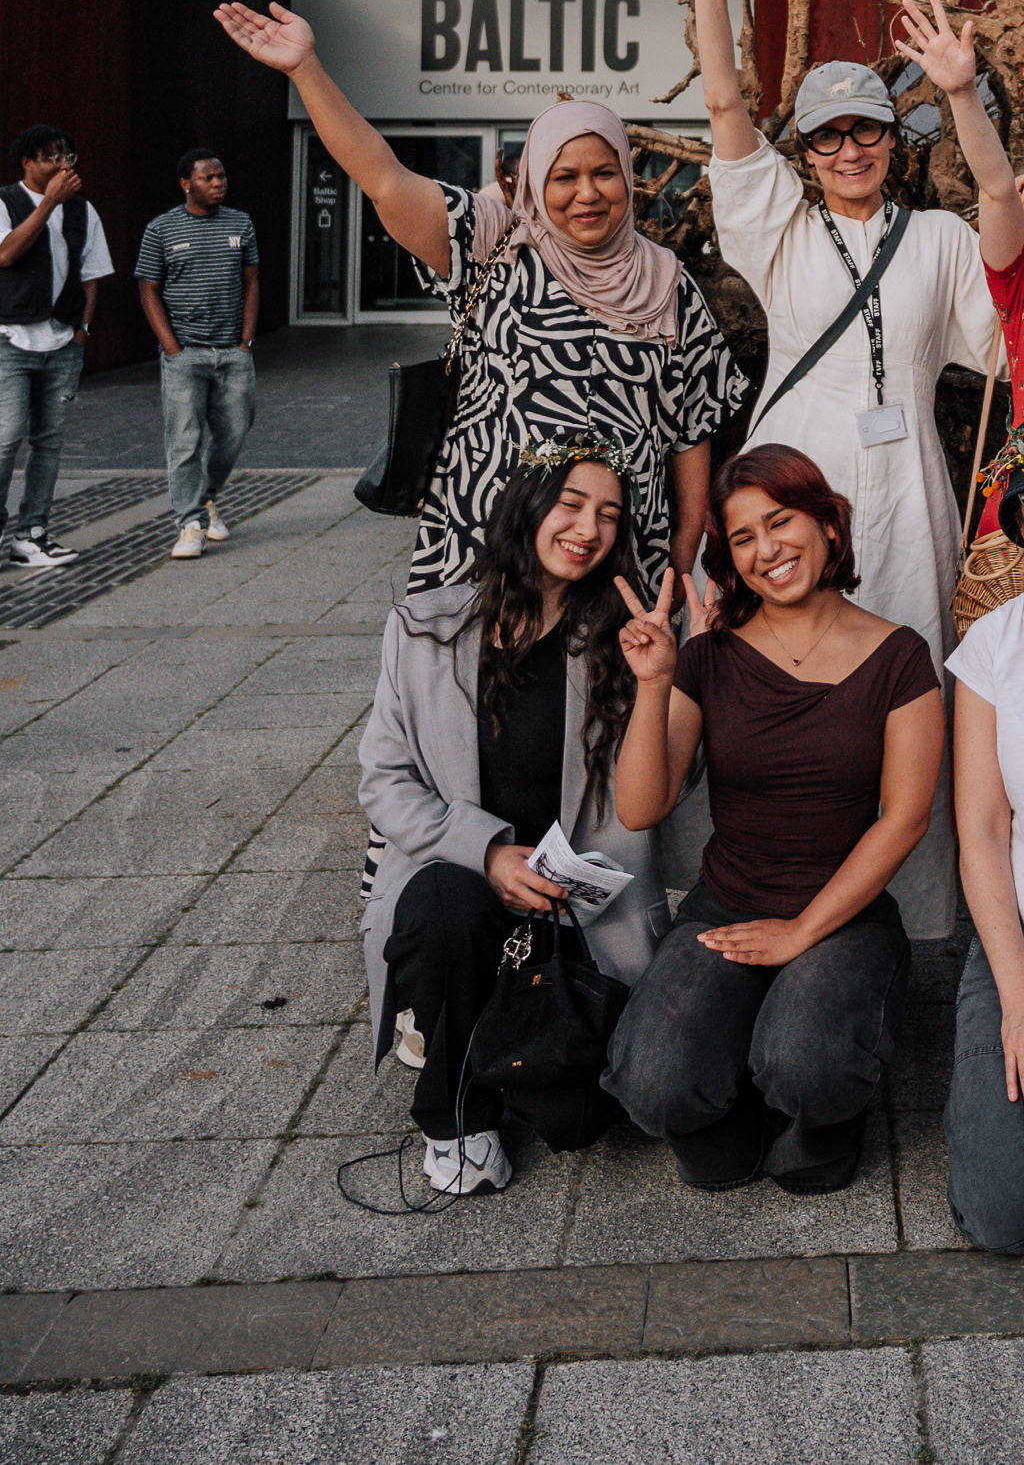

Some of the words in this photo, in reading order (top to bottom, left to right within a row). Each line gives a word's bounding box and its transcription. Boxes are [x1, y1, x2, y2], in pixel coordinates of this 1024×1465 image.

[419, 80, 473, 95] Centre
[477, 80, 498, 95] for
[502, 80, 614, 100] Contemporary
[618, 80, 641, 95] Art
[831, 228, 844, 246] STAFF
[842, 251, 856, 270] STAFF
[873, 297, 881, 317] STAFF
[863, 308, 874, 328] STAFF
